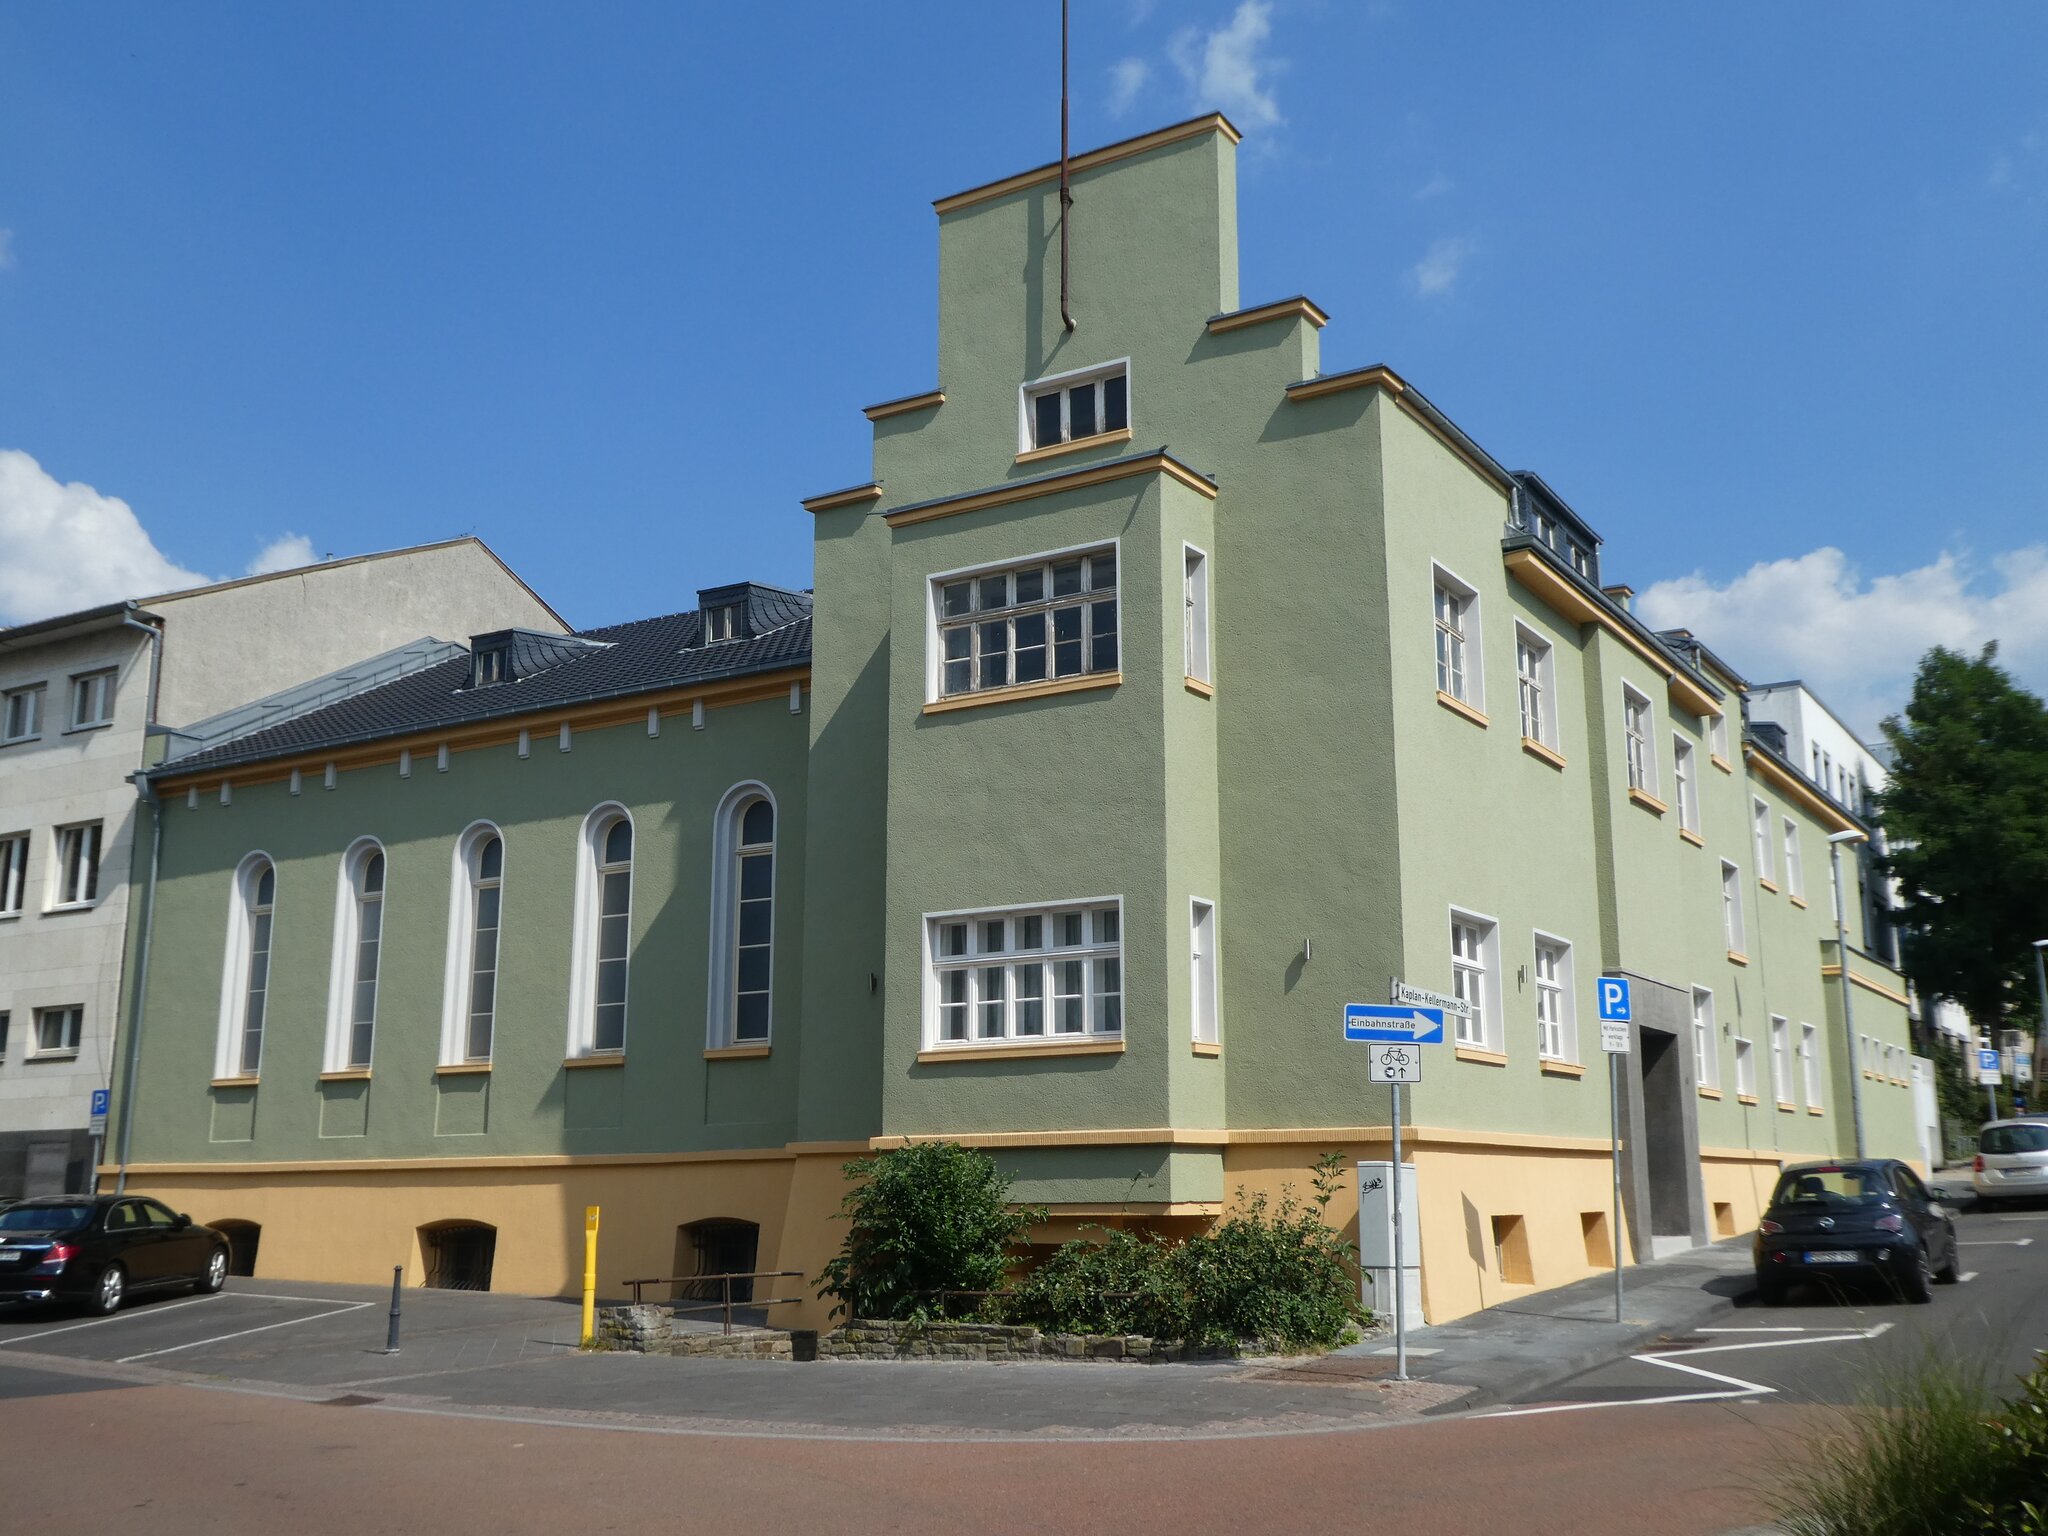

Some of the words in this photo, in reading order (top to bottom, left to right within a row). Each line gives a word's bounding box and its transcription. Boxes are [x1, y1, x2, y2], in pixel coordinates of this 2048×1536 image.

[1401, 986, 1471, 1015] Kaplan-Kellermann-Str.
[1604, 983, 1623, 1015] P
[1351, 1018, 1416, 1030] Einbahnstraße
